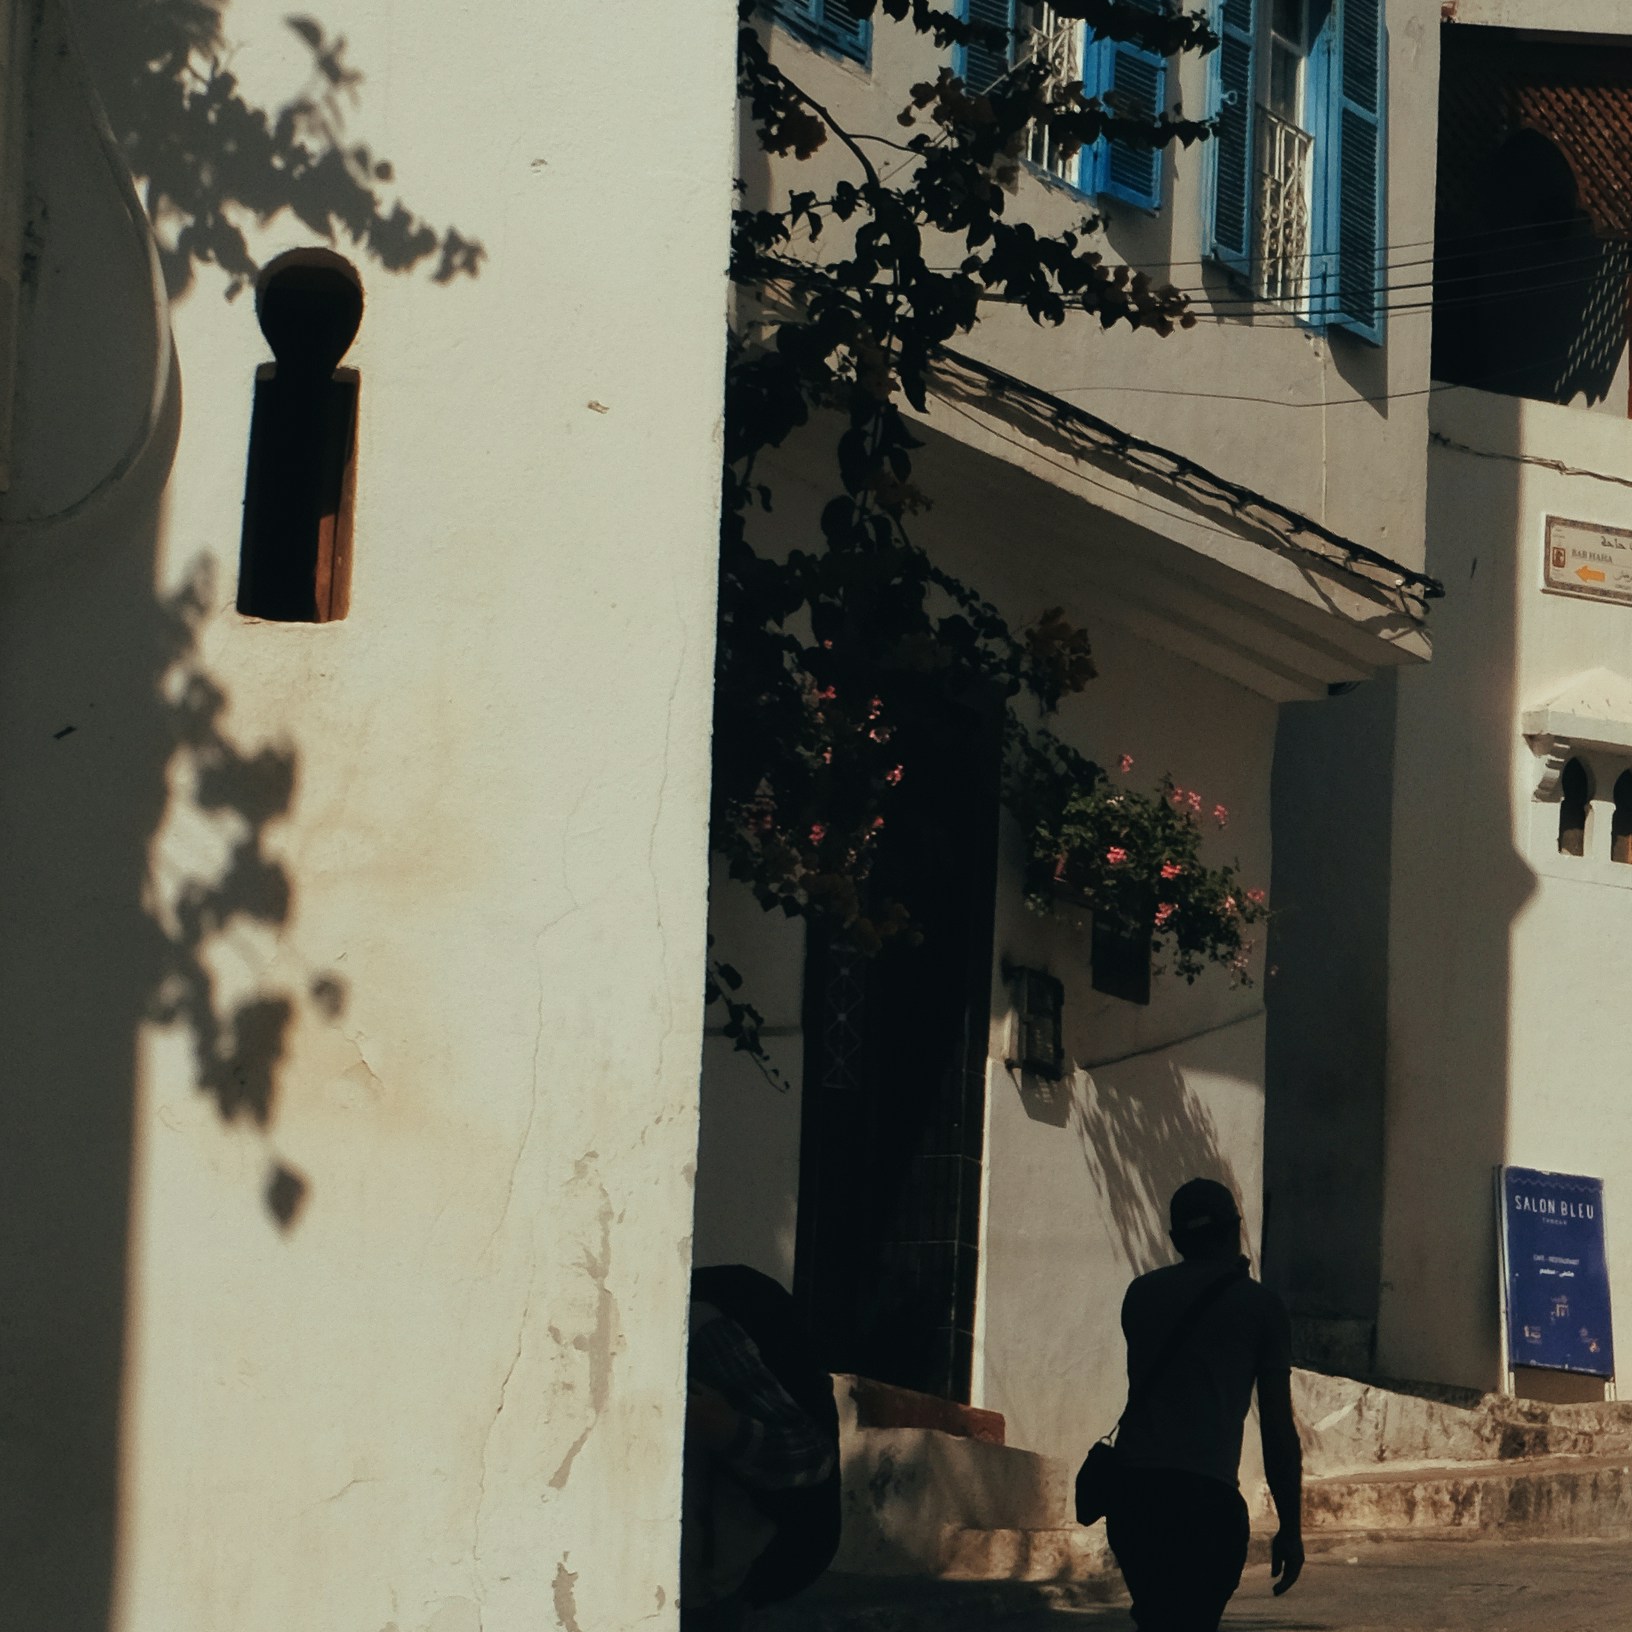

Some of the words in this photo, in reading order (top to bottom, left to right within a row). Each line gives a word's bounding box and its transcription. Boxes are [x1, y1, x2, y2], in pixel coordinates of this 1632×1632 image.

[1571, 548, 1588, 559] BAB
[1514, 1195, 1556, 1214] SALON
[1560, 1201, 1594, 1219] BLEU
